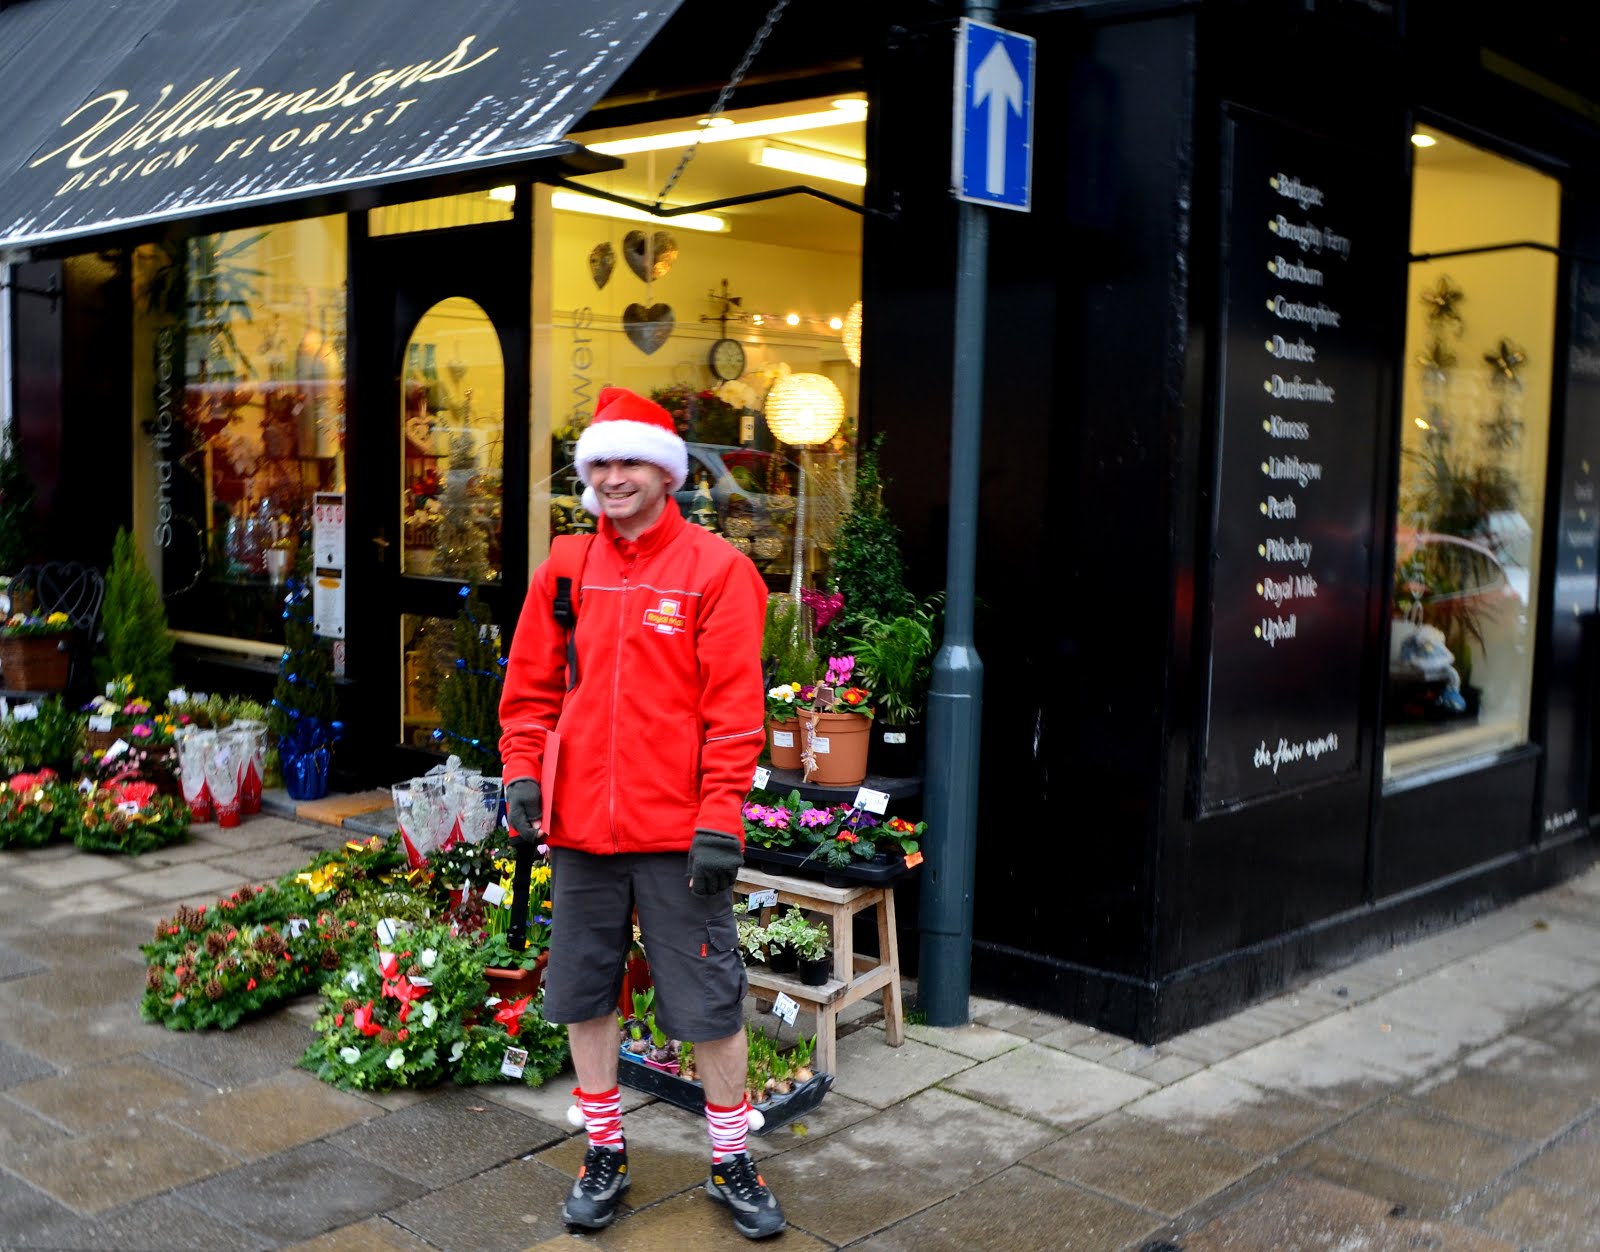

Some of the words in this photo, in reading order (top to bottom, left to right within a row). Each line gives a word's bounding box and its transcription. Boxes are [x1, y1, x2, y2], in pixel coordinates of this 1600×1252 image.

[30, 34, 500, 169] Williamsons
[54, 143, 200, 197] DESIGN
[213, 98, 419, 164] FLORIST
[155, 328, 173, 448] flowers
[153, 460, 173, 549] Send
[1267, 494, 1297, 519] Perth
[1261, 614, 1297, 648] Uphall
[1263, 575, 1293, 608] Royal
[1294, 573, 1318, 599] Mile
